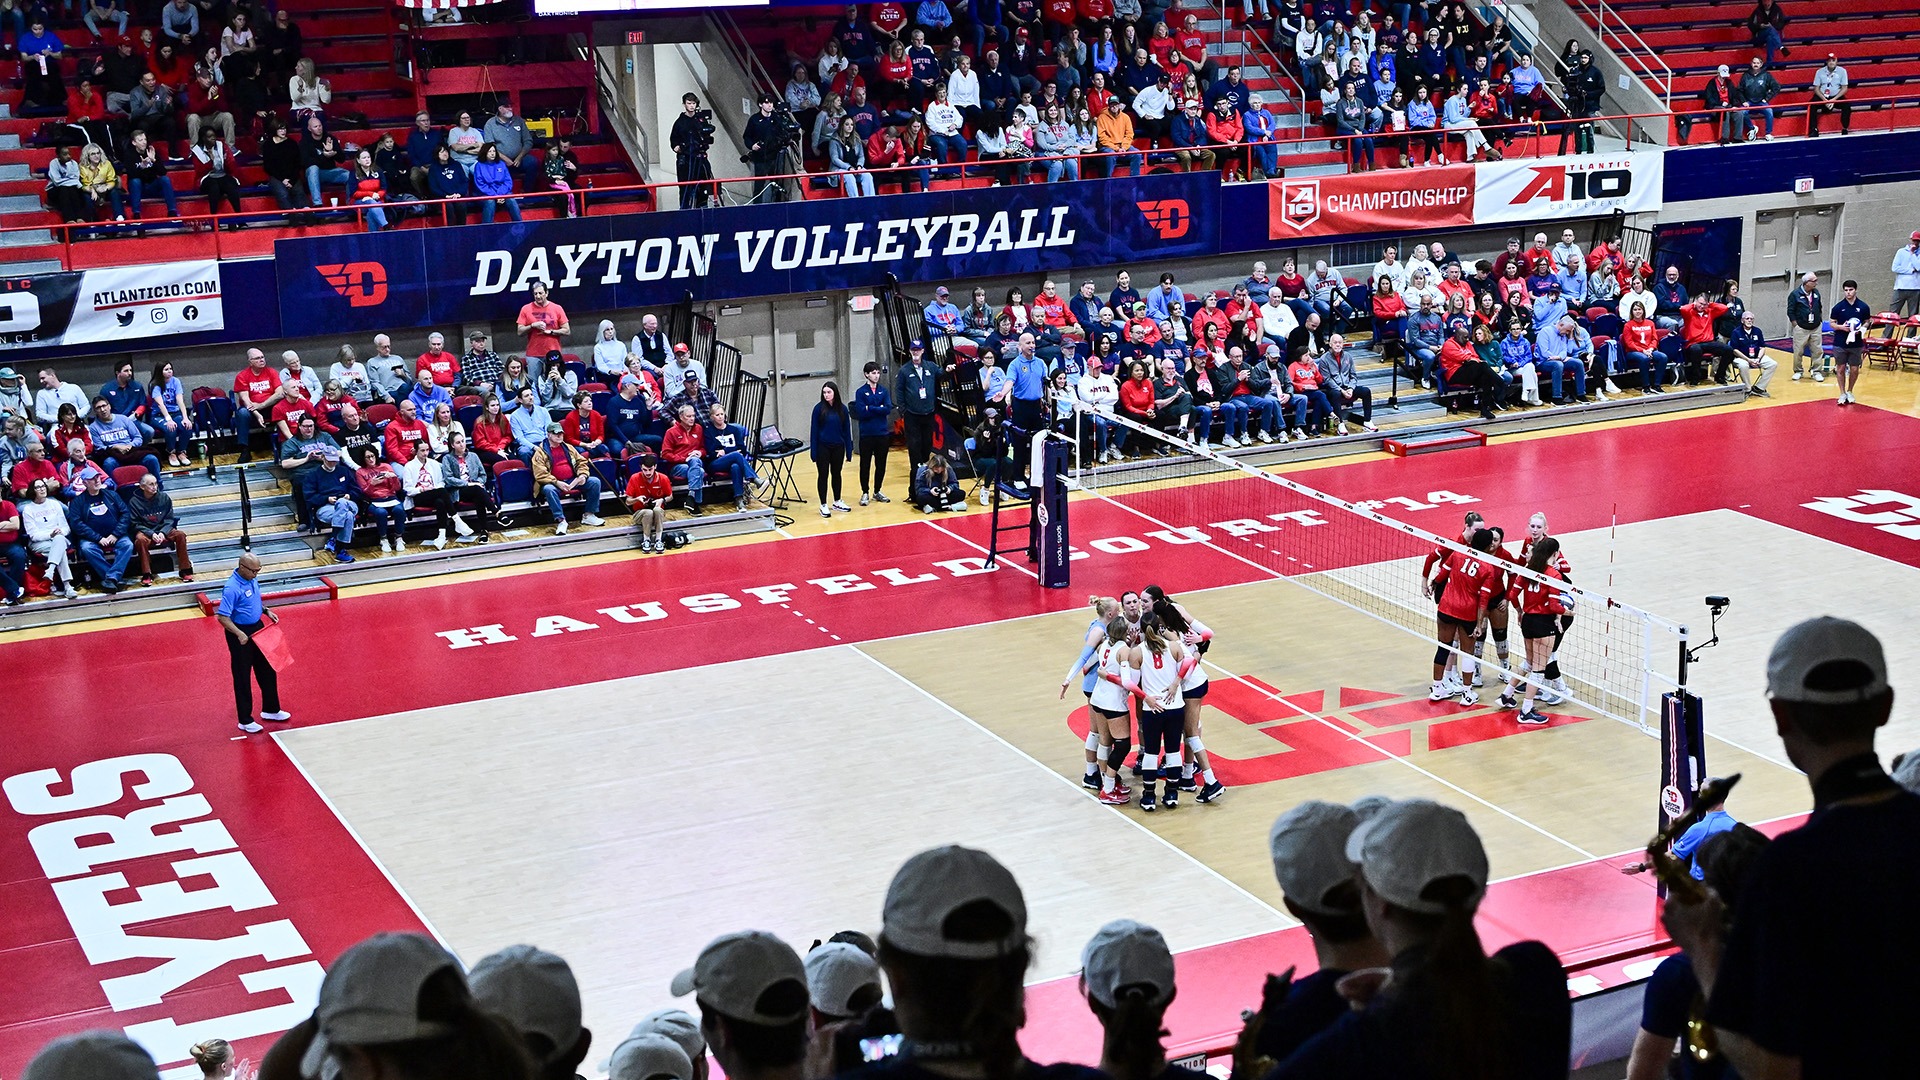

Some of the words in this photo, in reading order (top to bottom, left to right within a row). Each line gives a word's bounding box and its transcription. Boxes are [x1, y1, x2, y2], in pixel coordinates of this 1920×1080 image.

[628, 31, 643, 44] EXIT
[1801, 180, 1813, 192] EXIT
[1326, 186, 1468, 214] CHAMPIONSHIP
[1549, 199, 1630, 211] CONFERENCE
[470, 233, 720, 296] DAYTON
[734, 205, 1077, 273] VOLLEYBALL
[1315, 279, 1337, 291] DAYTON
[93, 280, 217, 306] ATLANTIC10.COM
[857, 295, 872, 309] EXIT
[1640, 332, 1646, 344] 1
[100, 429, 130, 443] DAYTON
[434, 556, 1001, 650] HAUSFELD
[1352, 488, 1483, 512] #14
[1459, 557, 1481, 578] 16
[1152, 651, 1164, 670] 8
[2, 752, 329, 1080] LYERS
[1180, 1058, 1205, 1070] TION
